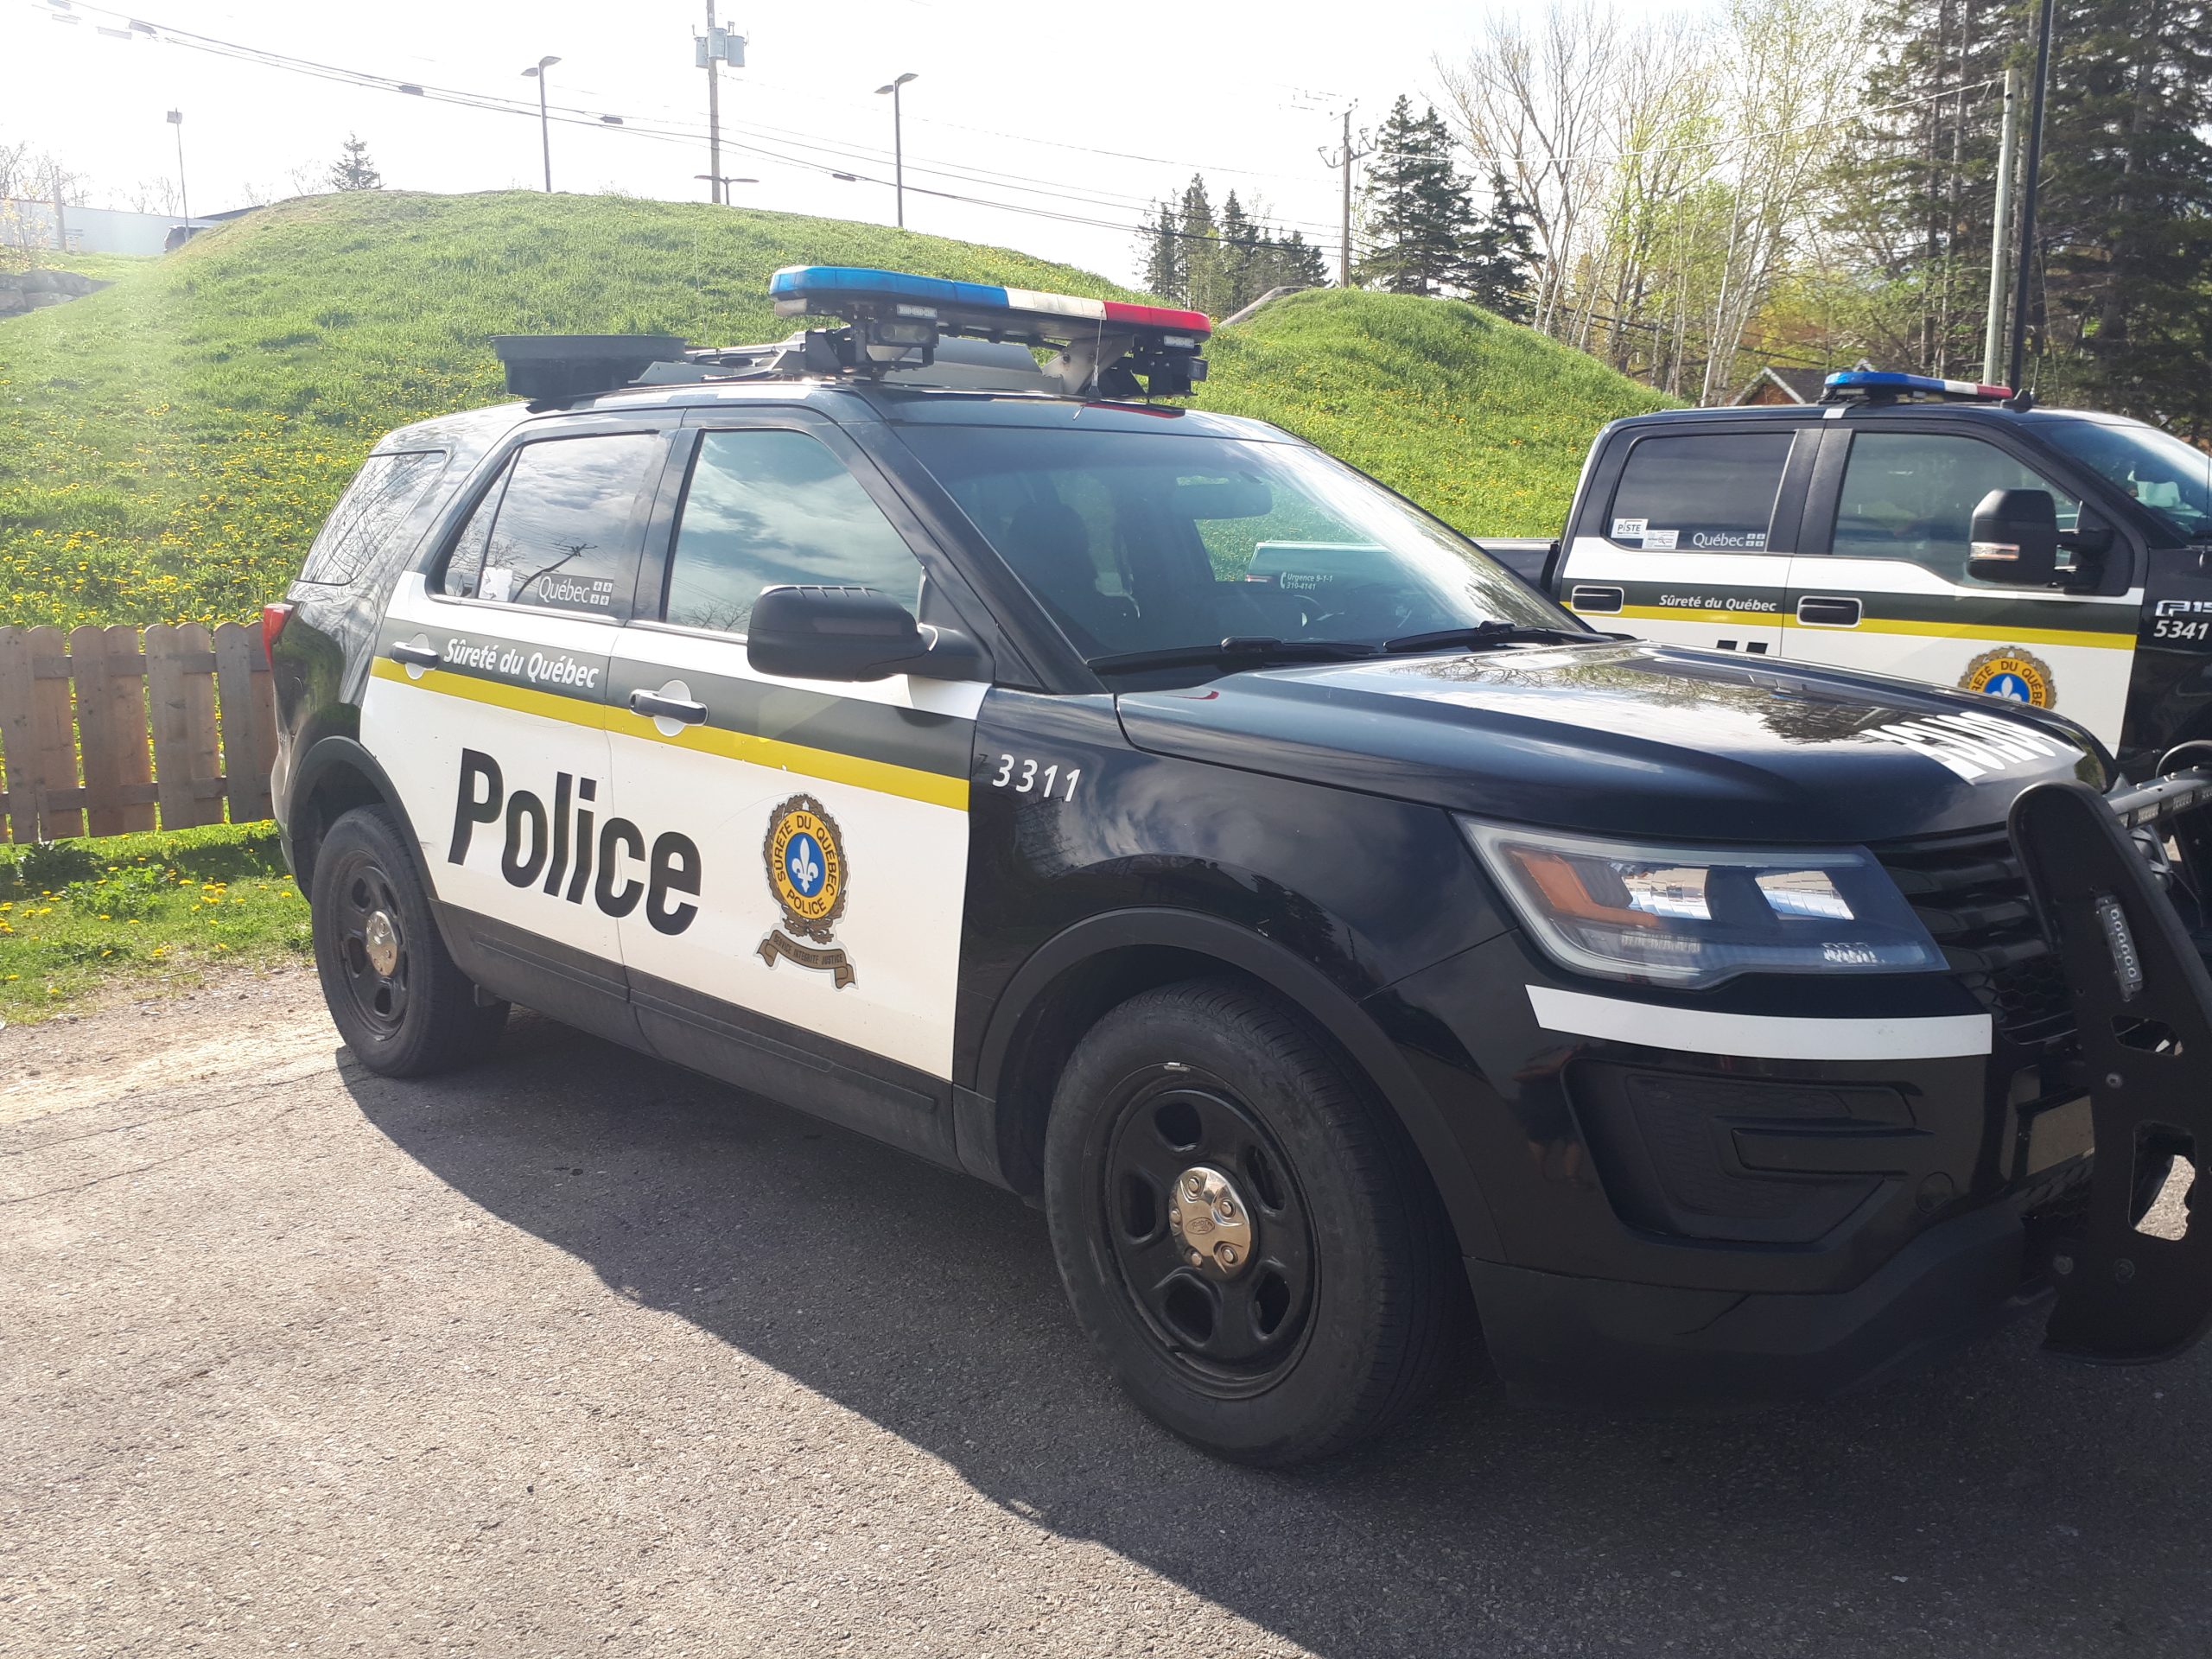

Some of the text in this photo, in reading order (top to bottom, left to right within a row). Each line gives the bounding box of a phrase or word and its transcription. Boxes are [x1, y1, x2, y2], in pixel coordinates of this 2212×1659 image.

[1693, 532, 1745, 548] Québec
[539, 576, 589, 603] Québec
[1659, 594, 1777, 612] Sûreté du Québec
[2153, 620, 2209, 640] 5341
[443, 639, 599, 688] Sûreté du Québec
[2000, 660, 2018, 671] DU
[2022, 668, 2043, 706] QUÉBE
[992, 753, 1081, 803] 3311
[448, 747, 702, 936] Police
[797, 815, 812, 830] DU
[816, 827, 837, 896] QUÉBEC
[786, 889, 827, 915] POLICE
[774, 933, 792, 955] SERVICE
[822, 953, 843, 965] JUSTICE
